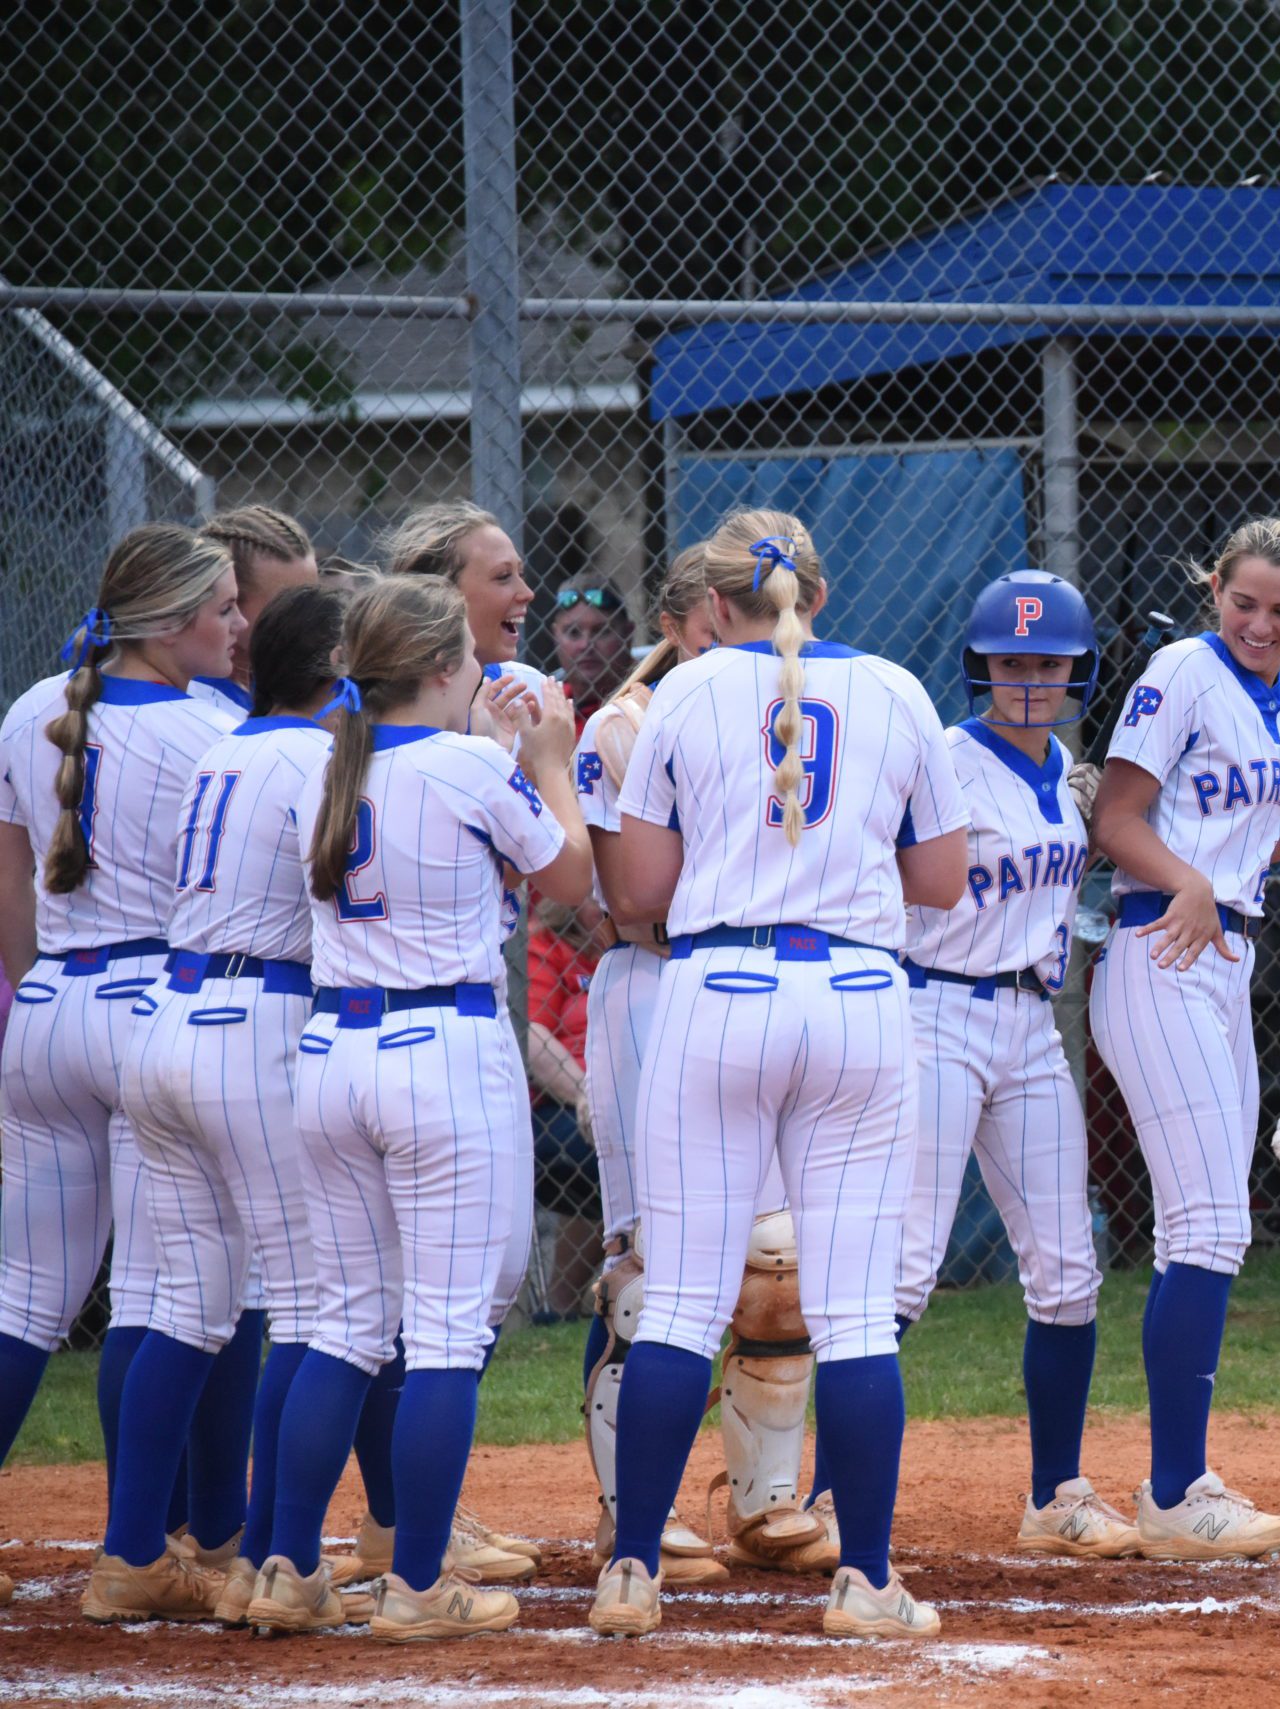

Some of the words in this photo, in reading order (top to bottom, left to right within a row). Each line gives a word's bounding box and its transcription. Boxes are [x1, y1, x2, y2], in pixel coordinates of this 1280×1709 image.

[1015, 597, 1042, 636] P
[1124, 685, 1163, 727] P
[761, 697, 839, 830] 9
[176, 771, 242, 893] 11
[332, 796, 388, 923] 2
[968, 841, 1088, 911] PATRIO
[1193, 1512, 1229, 1541] N
[447, 1591, 473, 1620] N
[898, 1594, 915, 1625] N
